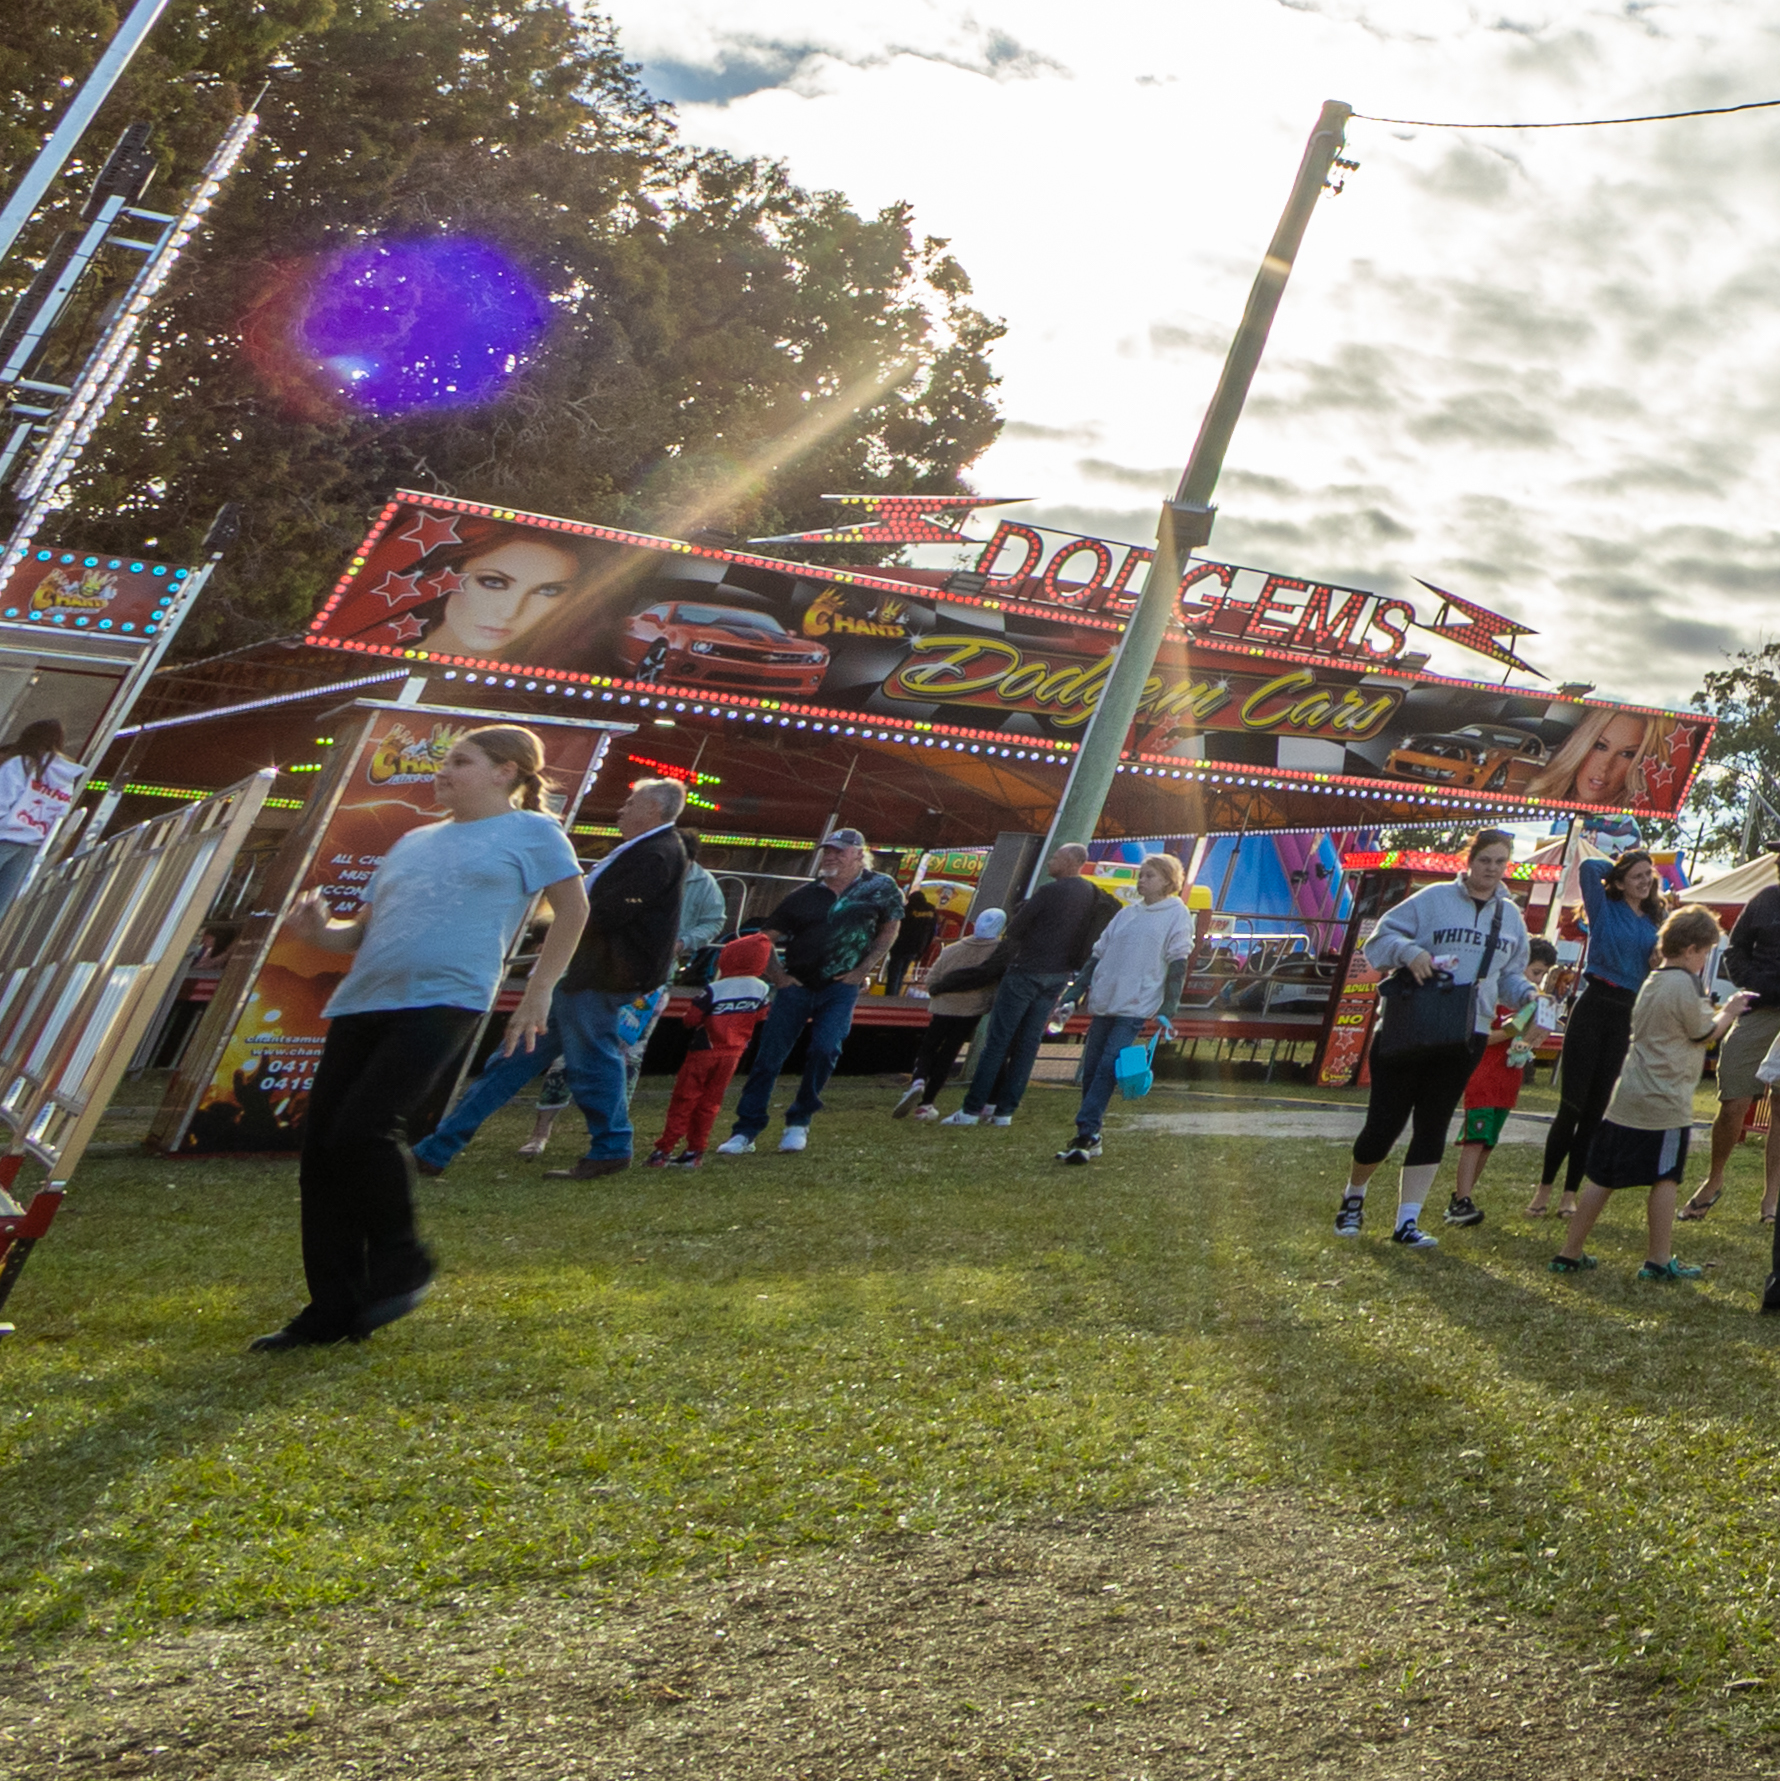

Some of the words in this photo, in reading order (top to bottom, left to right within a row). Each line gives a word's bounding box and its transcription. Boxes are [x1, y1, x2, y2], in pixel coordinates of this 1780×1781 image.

[803, 600, 906, 637] CHANTS
[1240, 668, 1396, 730] Cars
[331, 853, 353, 864] ALL
[1433, 927, 1483, 946] WHITE
[1337, 1014, 1364, 1025] NO
